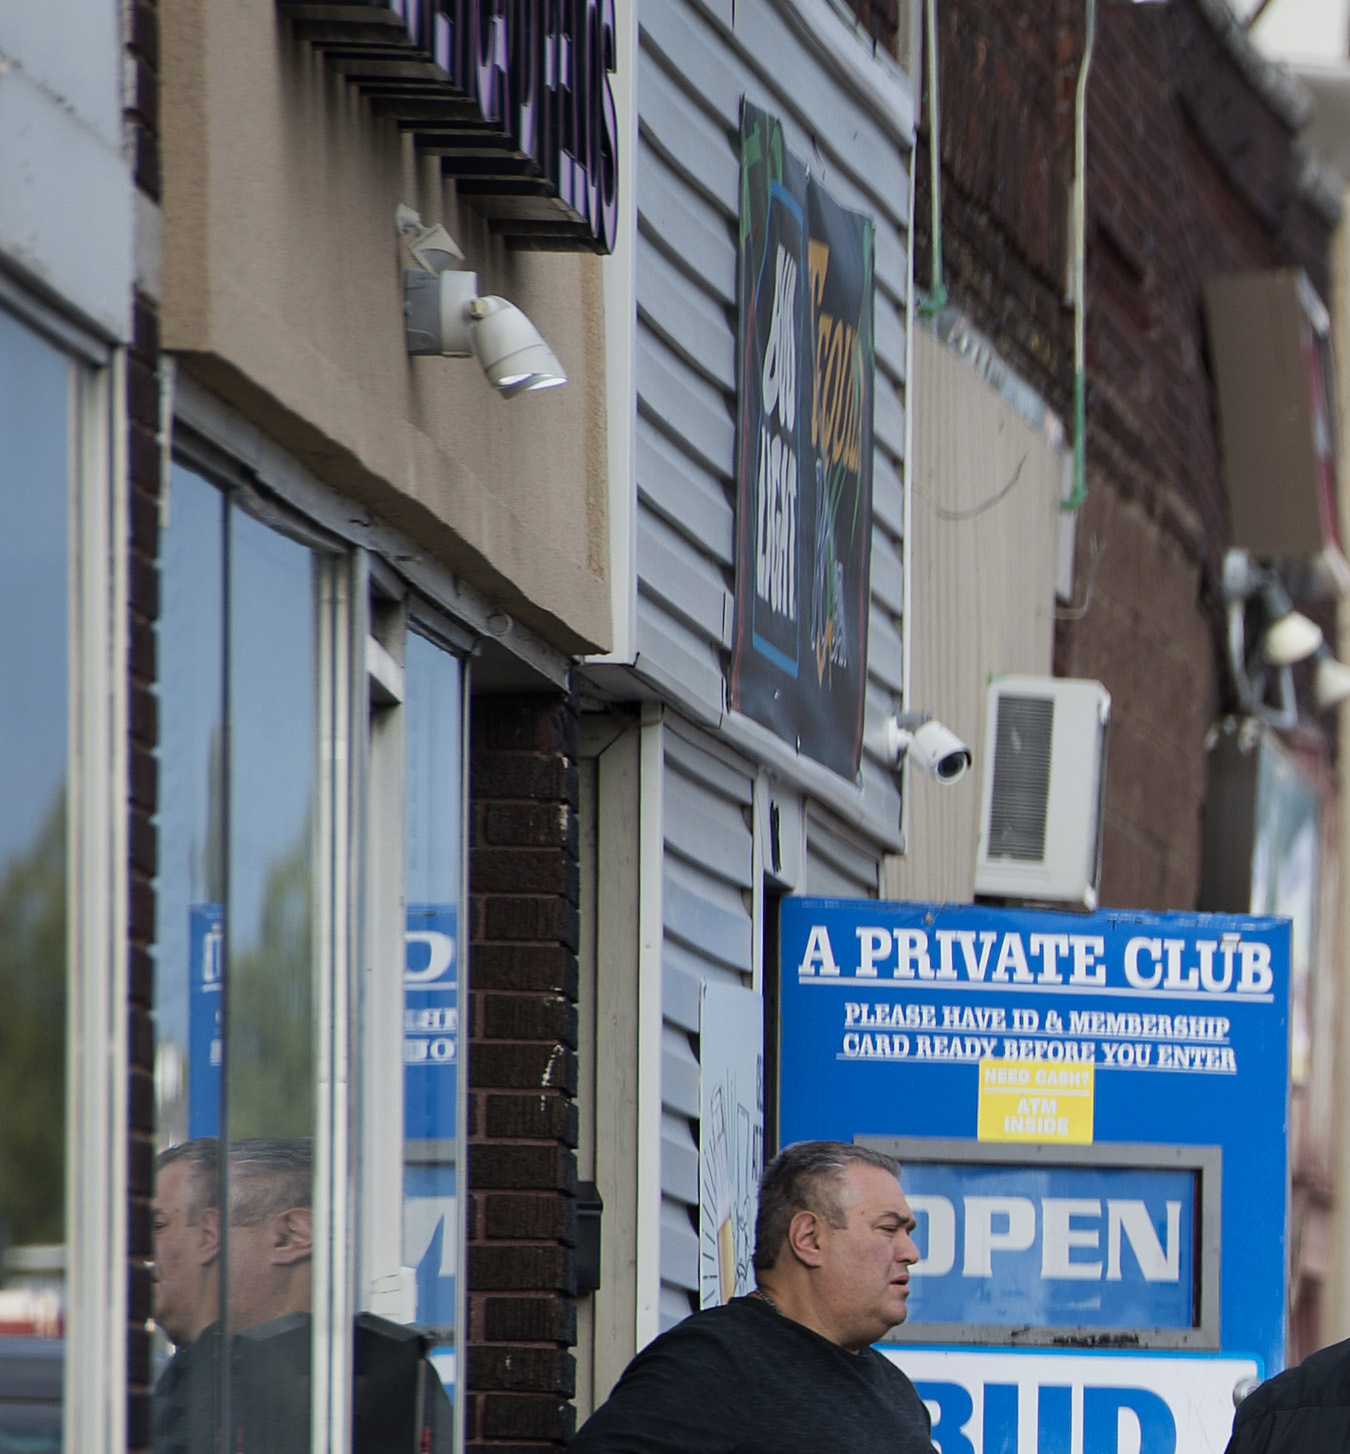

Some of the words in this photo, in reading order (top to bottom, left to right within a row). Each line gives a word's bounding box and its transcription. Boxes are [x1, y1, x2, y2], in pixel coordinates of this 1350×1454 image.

[763, 242, 797, 433] BUD
[756, 425, 797, 624] LIGHT
[798, 925, 840, 976] A
[855, 926, 1106, 987] PRIVATE
[1123, 936, 1275, 993] CLUB
[844, 1002, 937, 1030] PLEASE
[943, 1006, 1007, 1031] HAVE
[1012, 1008, 1040, 1033] ID
[1045, 1010, 1064, 1034] &
[1069, 1011, 1231, 1041] MEMBERSHIP
[842, 1033, 911, 1058] CARD
[915, 1036, 999, 1060] READY
[1003, 1040, 1096, 1064] BEFORE
[1101, 1044, 1152, 1068] YOU
[1157, 1046, 1237, 1072] ENTER
[984, 1068, 1031, 1086] NEED
[1035, 1069, 1092, 1089] CASH?
[1003, 1115, 1070, 1136] INSIDE
[1016, 1097, 1058, 1116] ATM
